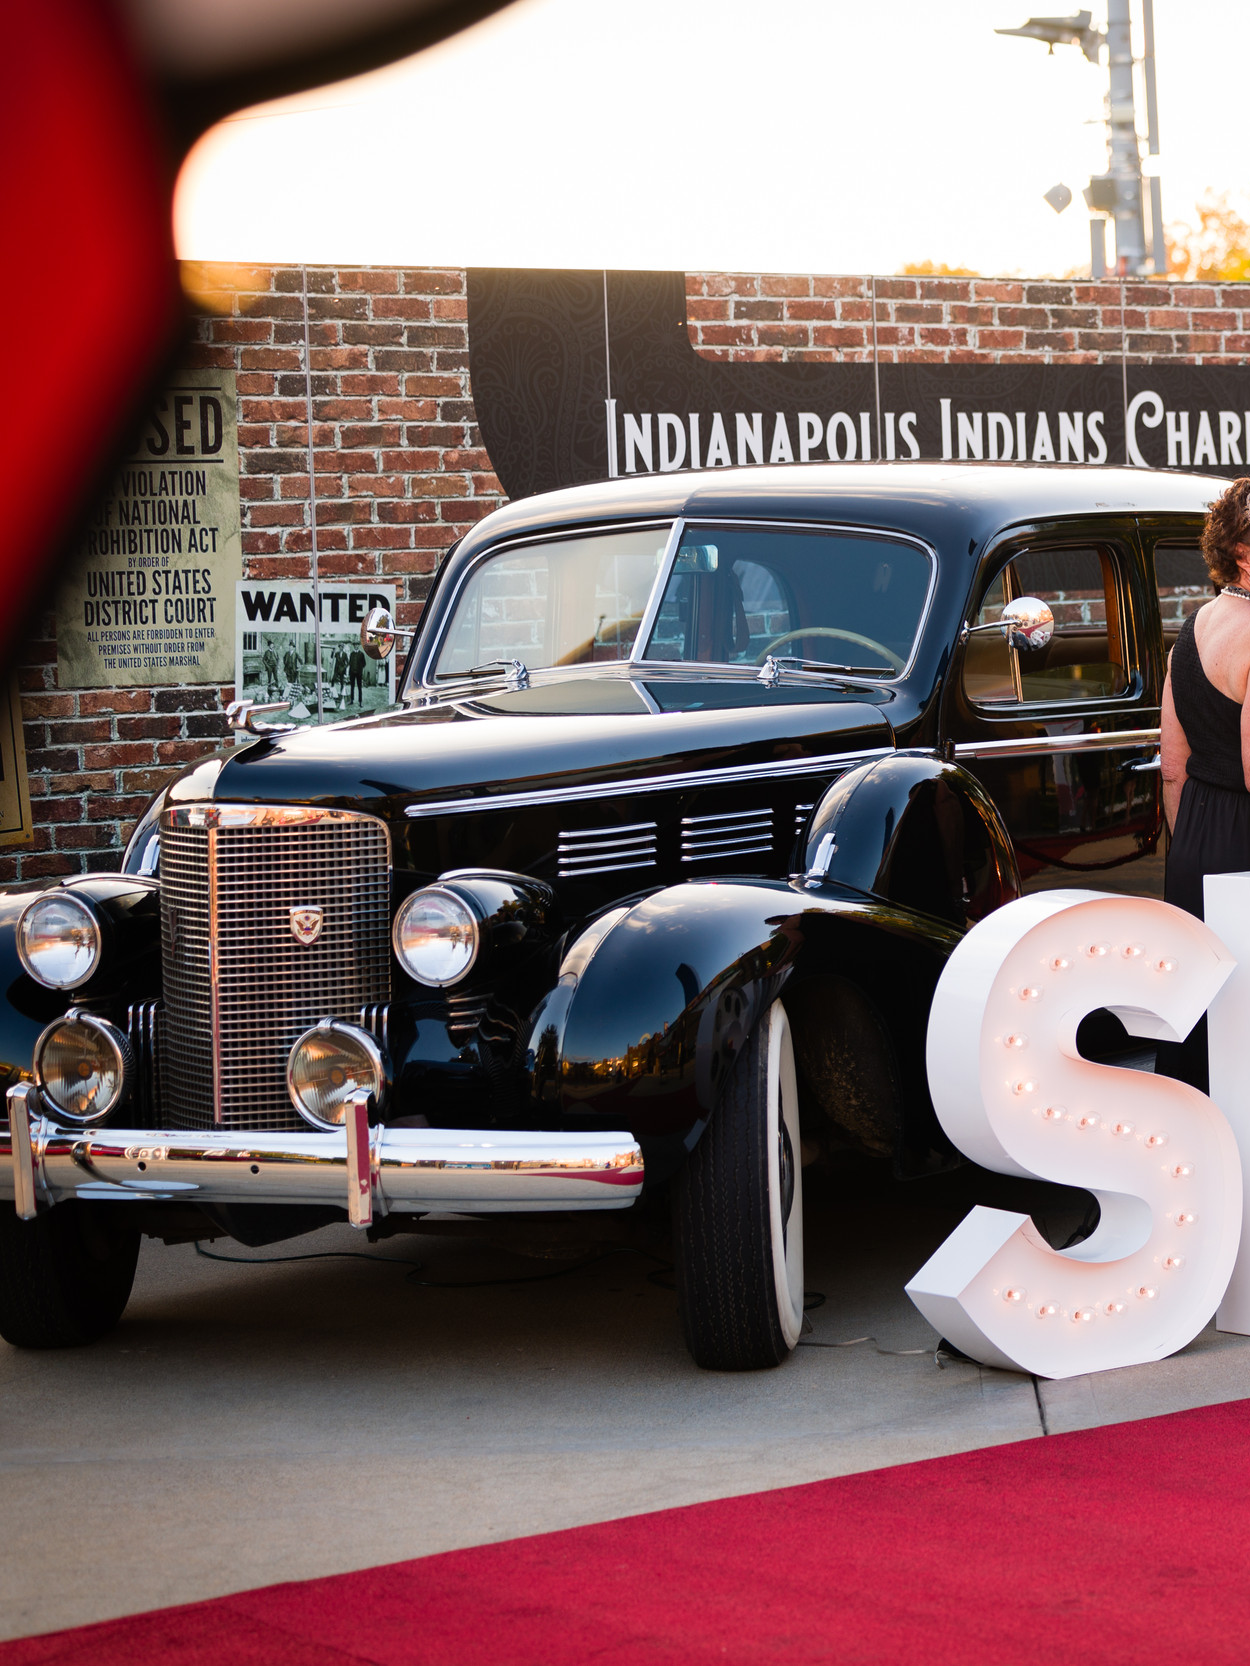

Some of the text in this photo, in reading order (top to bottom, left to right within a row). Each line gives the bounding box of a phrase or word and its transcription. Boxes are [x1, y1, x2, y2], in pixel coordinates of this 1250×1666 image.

[940, 398, 1108, 464] INDIANS
[121, 470, 207, 497] VIOLATION
[119, 499, 201, 526] NATIONAL
[80, 527, 219, 556] ROHIBITION ACT
[128, 556, 170, 568] BY ORDER OF
[87, 568, 212, 598] UNITED STATES
[84, 597, 217, 627] DISTRICT COURT
[87, 627, 215, 643] ALL PERSONS ARE FORBIDDEN TO ENTER
[98, 641, 205, 656] PREMISES WITHOUT ORDER FROM
[104, 655, 201, 669] THE UNITED STATES MARSHAL
